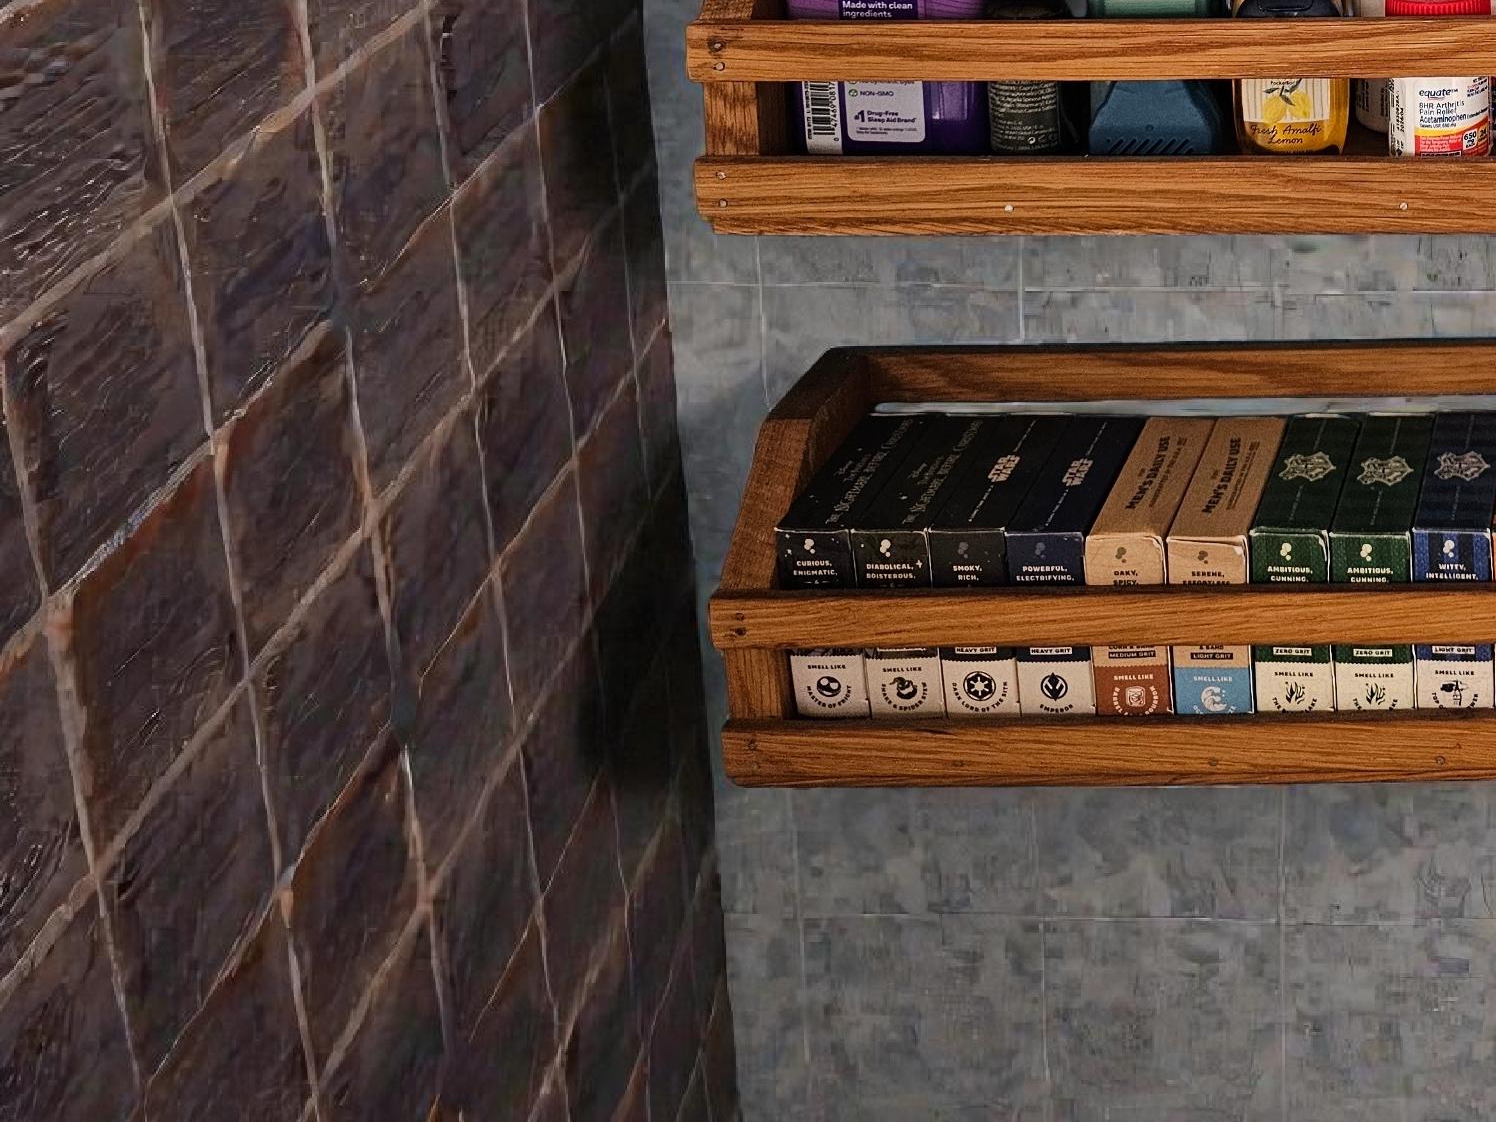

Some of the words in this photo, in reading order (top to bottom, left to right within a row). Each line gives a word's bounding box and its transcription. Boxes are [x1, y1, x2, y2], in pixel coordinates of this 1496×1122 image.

[842, 0, 866, 9] Made
[868, 1, 887, 9] with
[843, 9, 893, 18] ingredients
[1436, 100, 1465, 108] Arthritis
[1251, 124, 1278, 135] Fresh
[1283, 123, 1322, 136] Amalfi
[1267, 134, 1303, 144] Lemon
[1464, 131, 1477, 140] 650
[1157, 436, 1171, 454] USE
[1229, 437, 1242, 456] USE
[1220, 457, 1239, 483] DAILY
[1201, 484, 1229, 513] MEN'S
[1267, 566, 1313, 574] AMBITIOUS,
